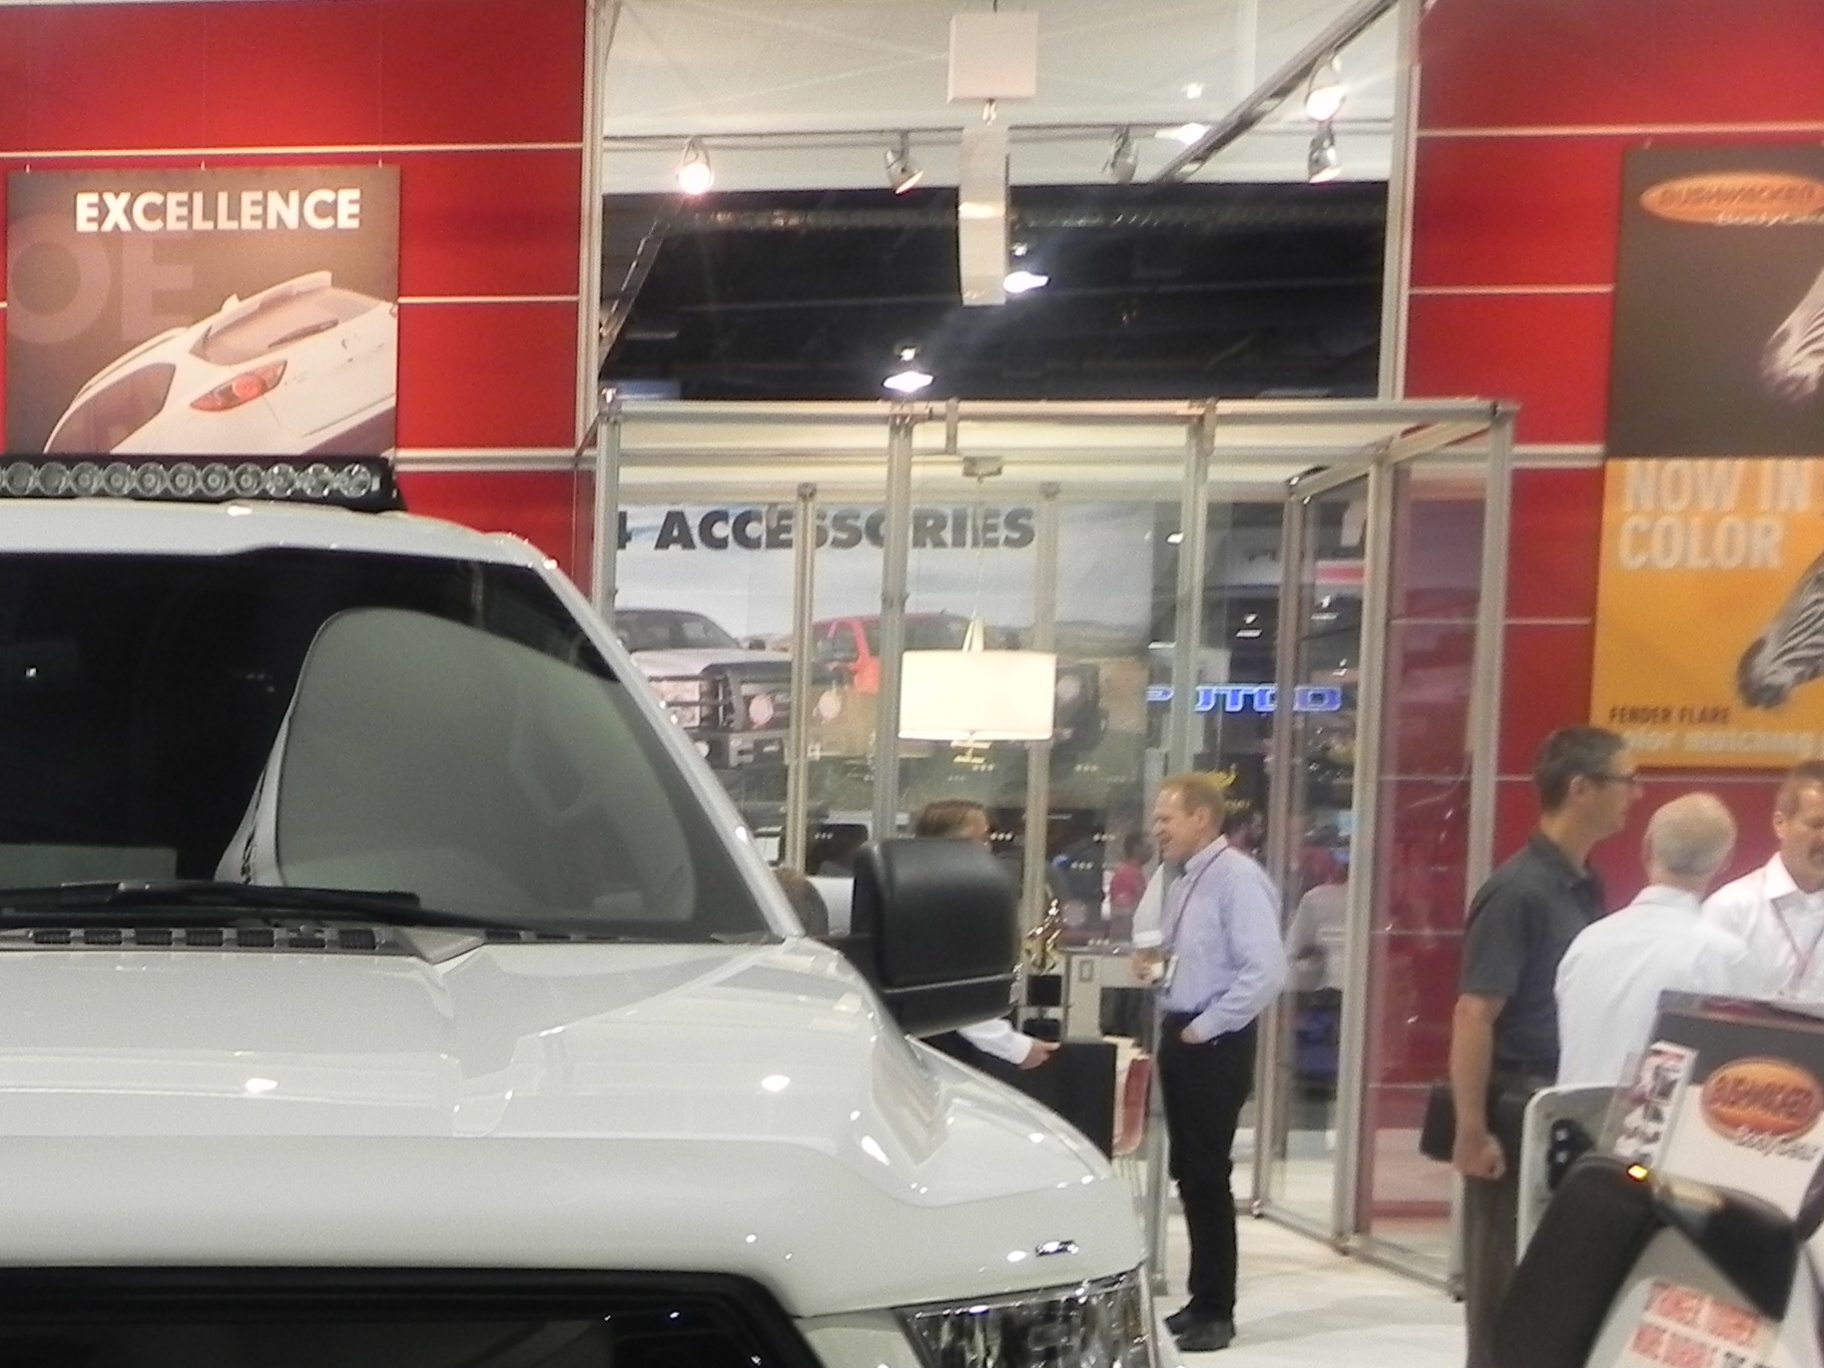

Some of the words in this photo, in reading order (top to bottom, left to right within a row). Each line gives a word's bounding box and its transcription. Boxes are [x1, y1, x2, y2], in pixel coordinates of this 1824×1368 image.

[76, 188, 361, 232] EXCELLENCE
[1625, 459, 1744, 513] NOW
[1760, 459, 1812, 512] IN
[1619, 515, 1784, 570] COLOR
